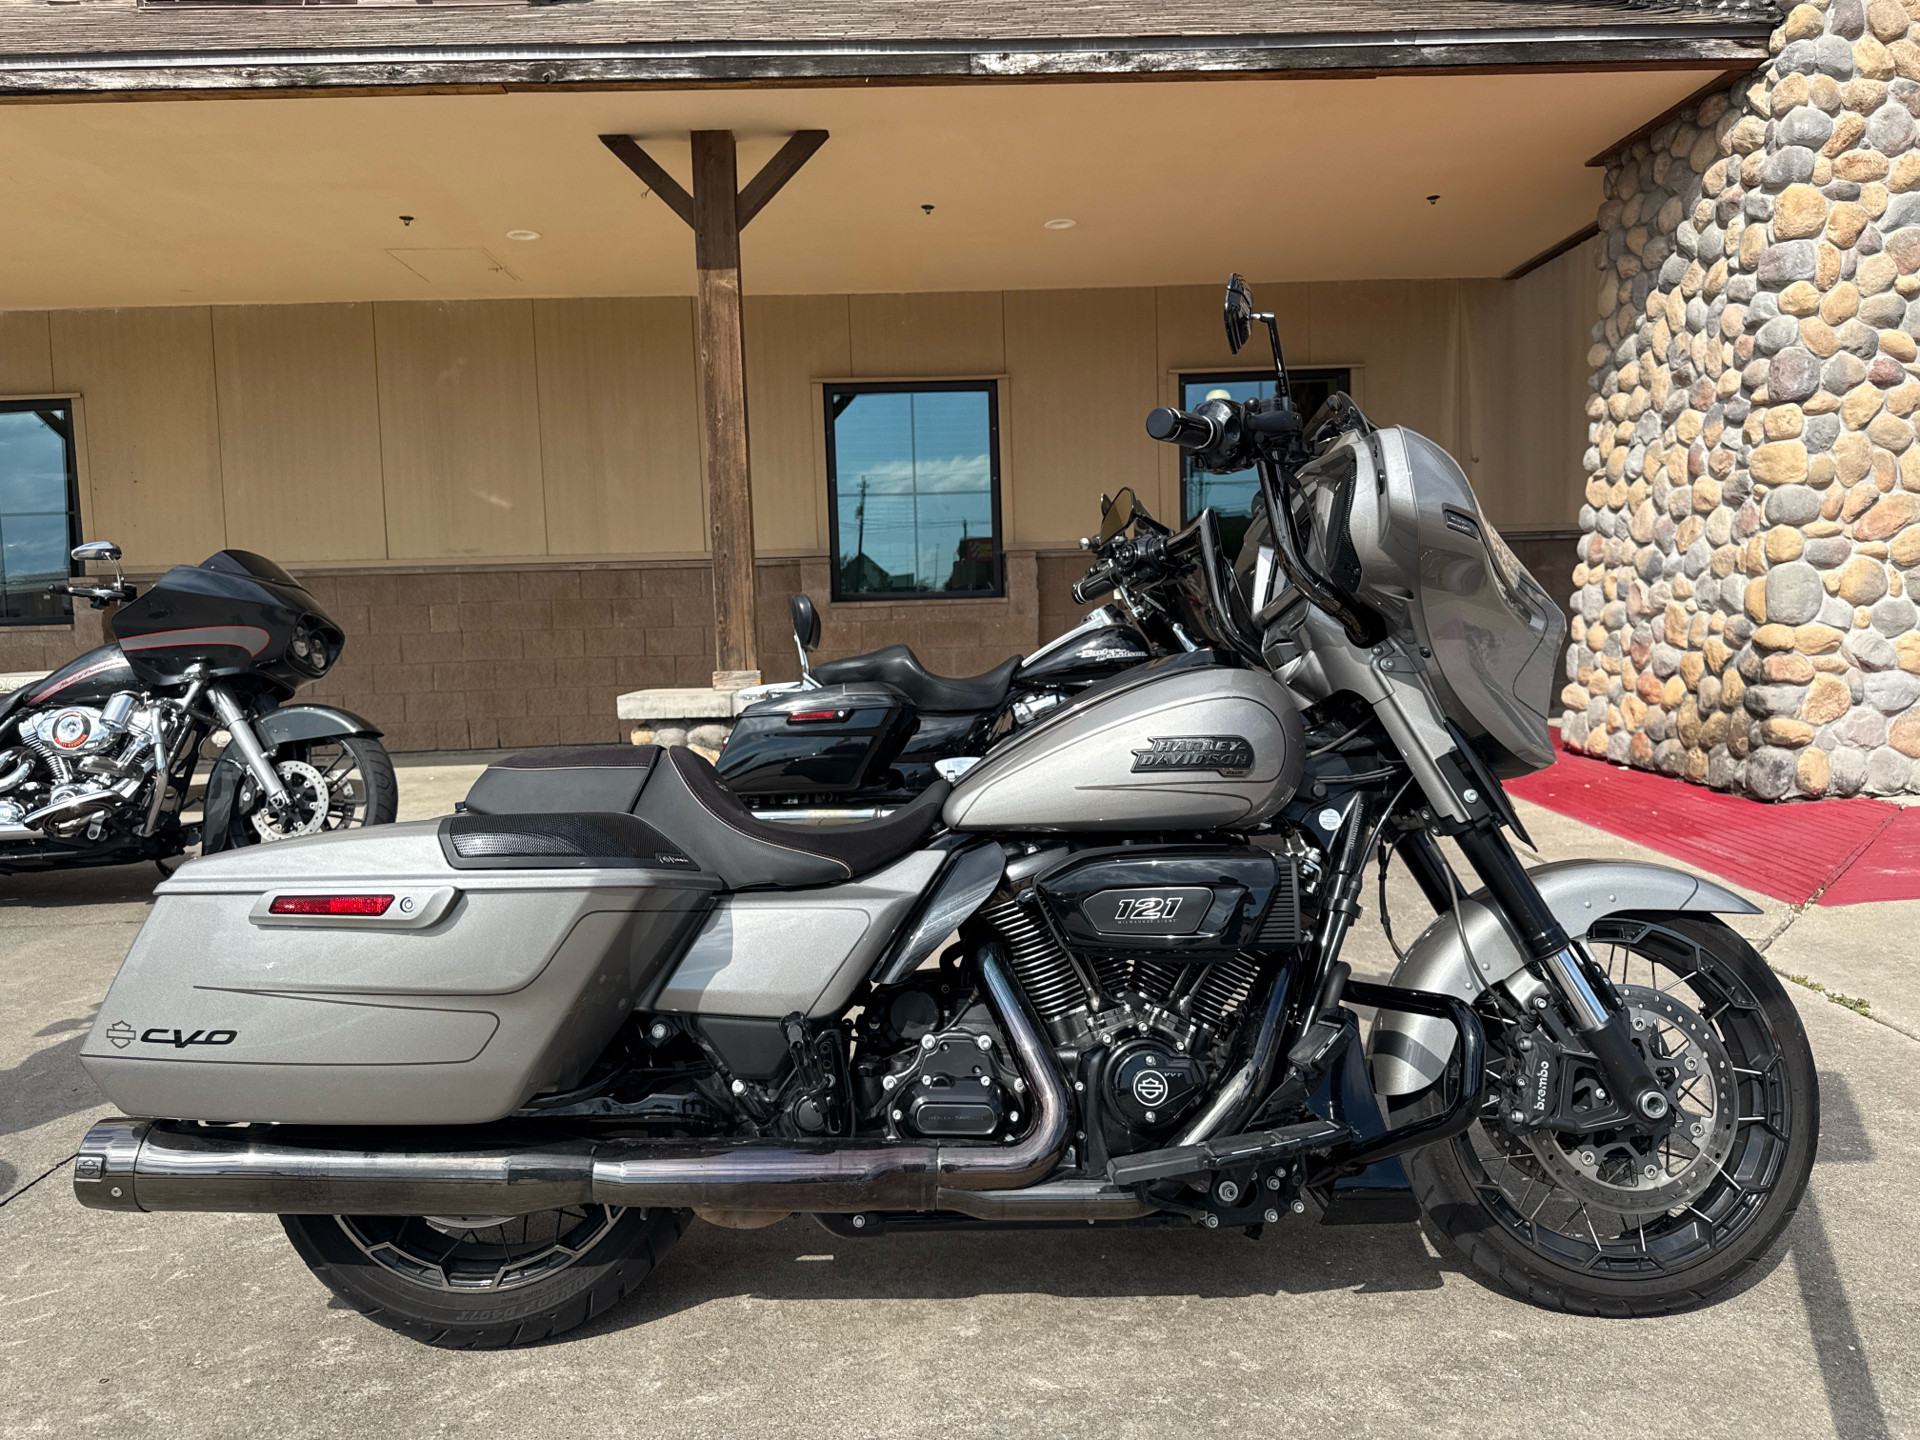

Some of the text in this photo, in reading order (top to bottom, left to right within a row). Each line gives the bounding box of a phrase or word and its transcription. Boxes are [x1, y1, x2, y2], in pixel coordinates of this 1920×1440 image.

[1140, 753, 1248, 767] DAVIDSON
[1115, 897, 1183, 919] 121
[140, 1028, 239, 1049] CVO
[1533, 1061, 1549, 1111] brembo
